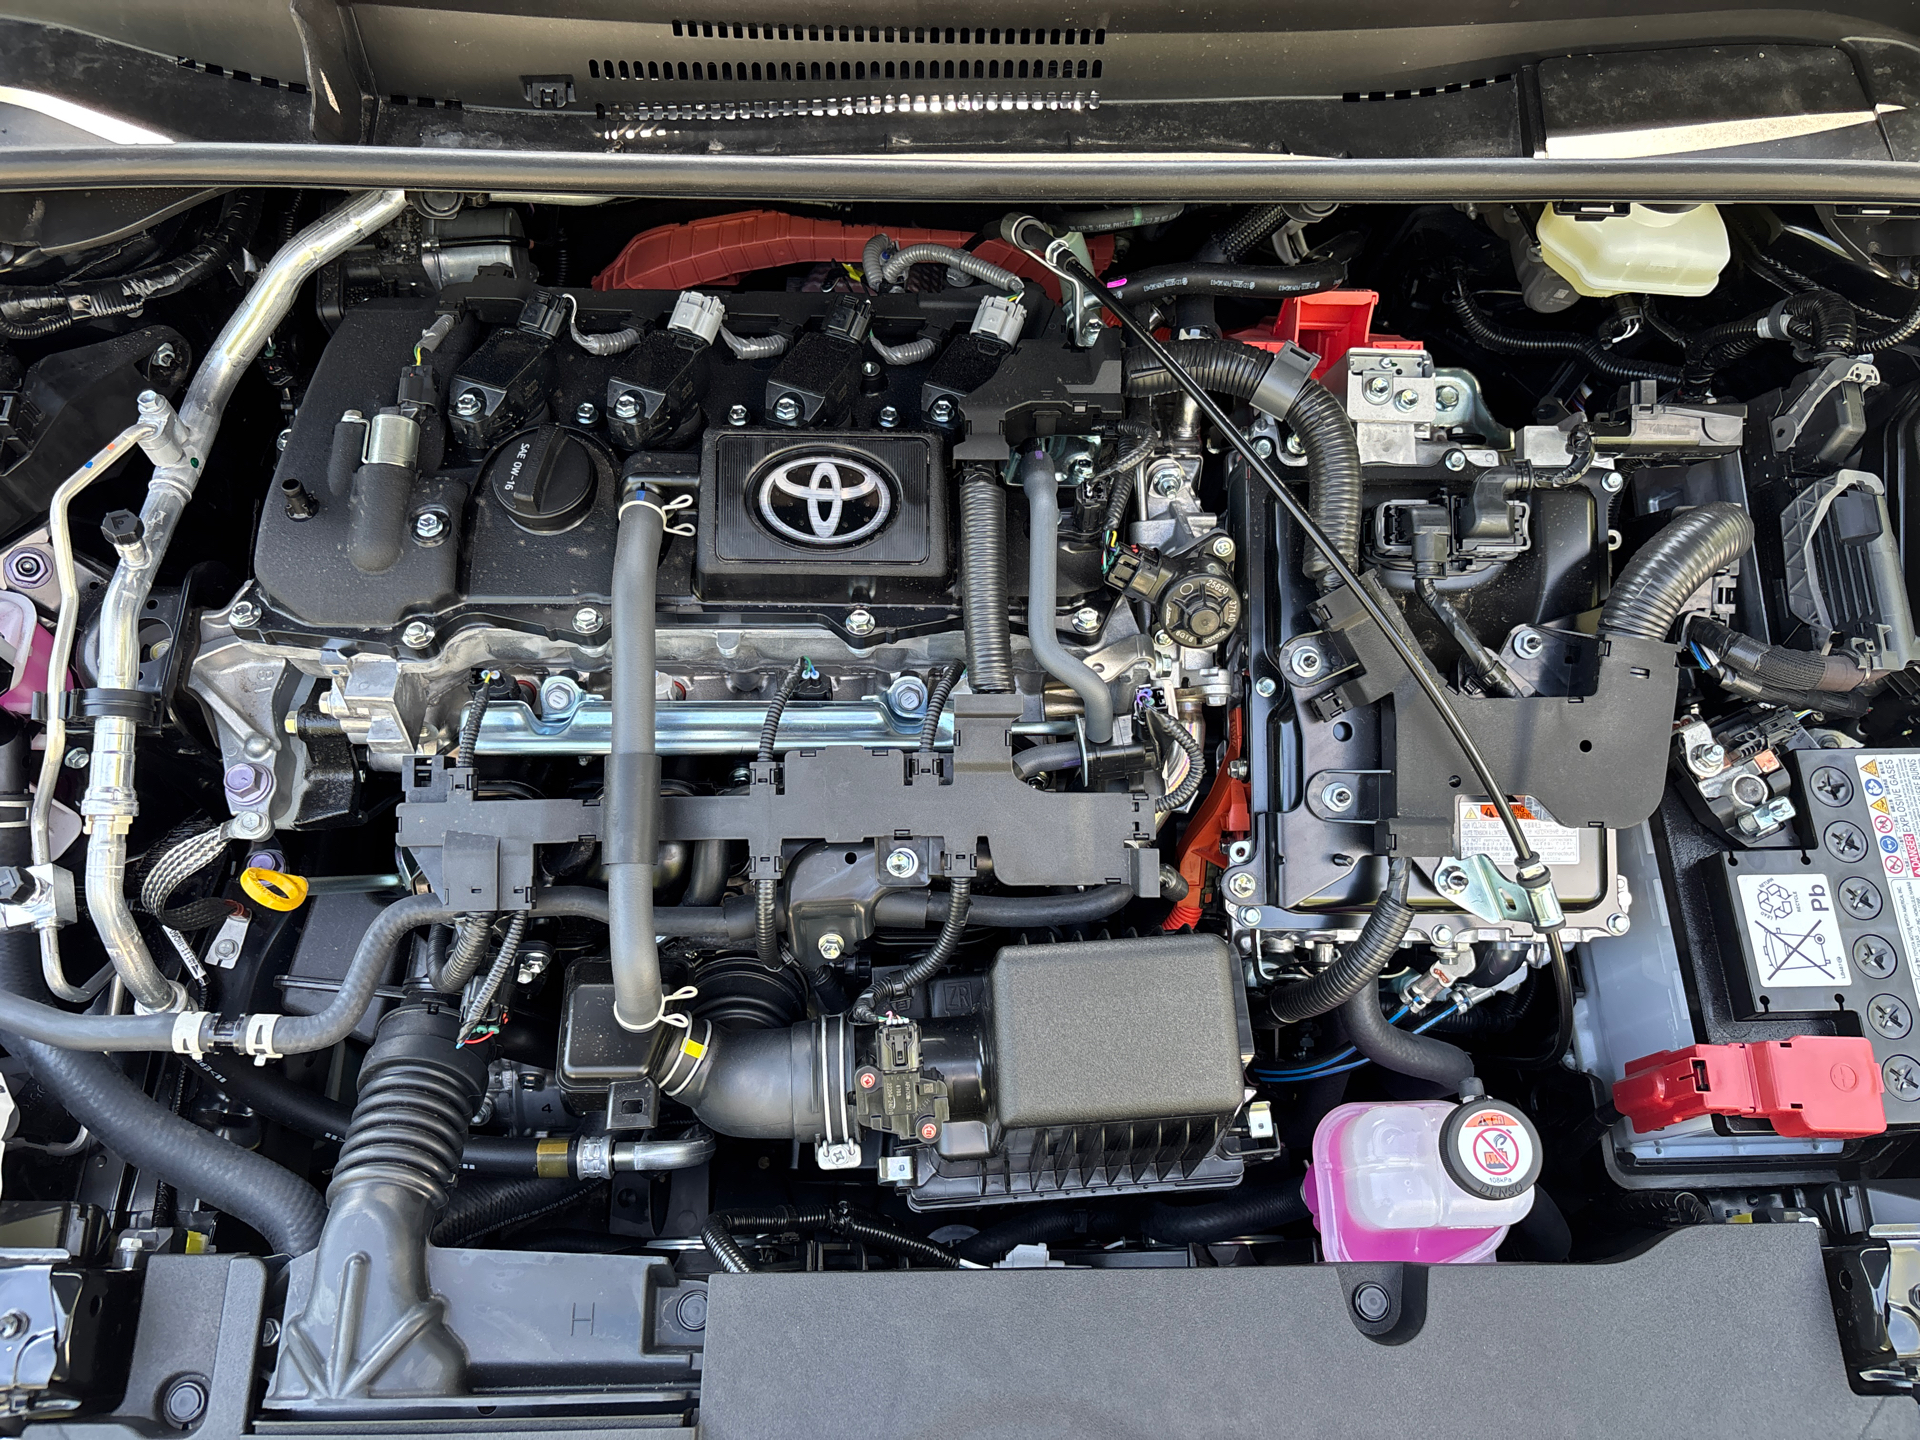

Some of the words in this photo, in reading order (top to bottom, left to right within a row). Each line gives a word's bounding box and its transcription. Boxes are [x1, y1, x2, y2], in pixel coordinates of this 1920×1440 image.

[517, 443, 530, 460] SAE
[504, 462, 523, 491] 0W-16
[1206, 579, 1229, 595] 25620
[1228, 600, 1237, 623] 37140
[1204, 629, 1227, 644] TOYOTA
[1884, 759, 1898, 786] GASES
[1892, 788, 1911, 833] EXPLOSIVE
[1904, 834, 1920, 868] DANGER
[1759, 878, 1774, 888] RETURN
[1792, 891, 1801, 912] RECYCLE
[1808, 884, 1829, 911] Pb
[1760, 911, 1773, 920] LEAD
[541, 1103, 553, 1114] 4
[1479, 1183, 1523, 1198] DENSO
[570, 1301, 596, 1337] H
